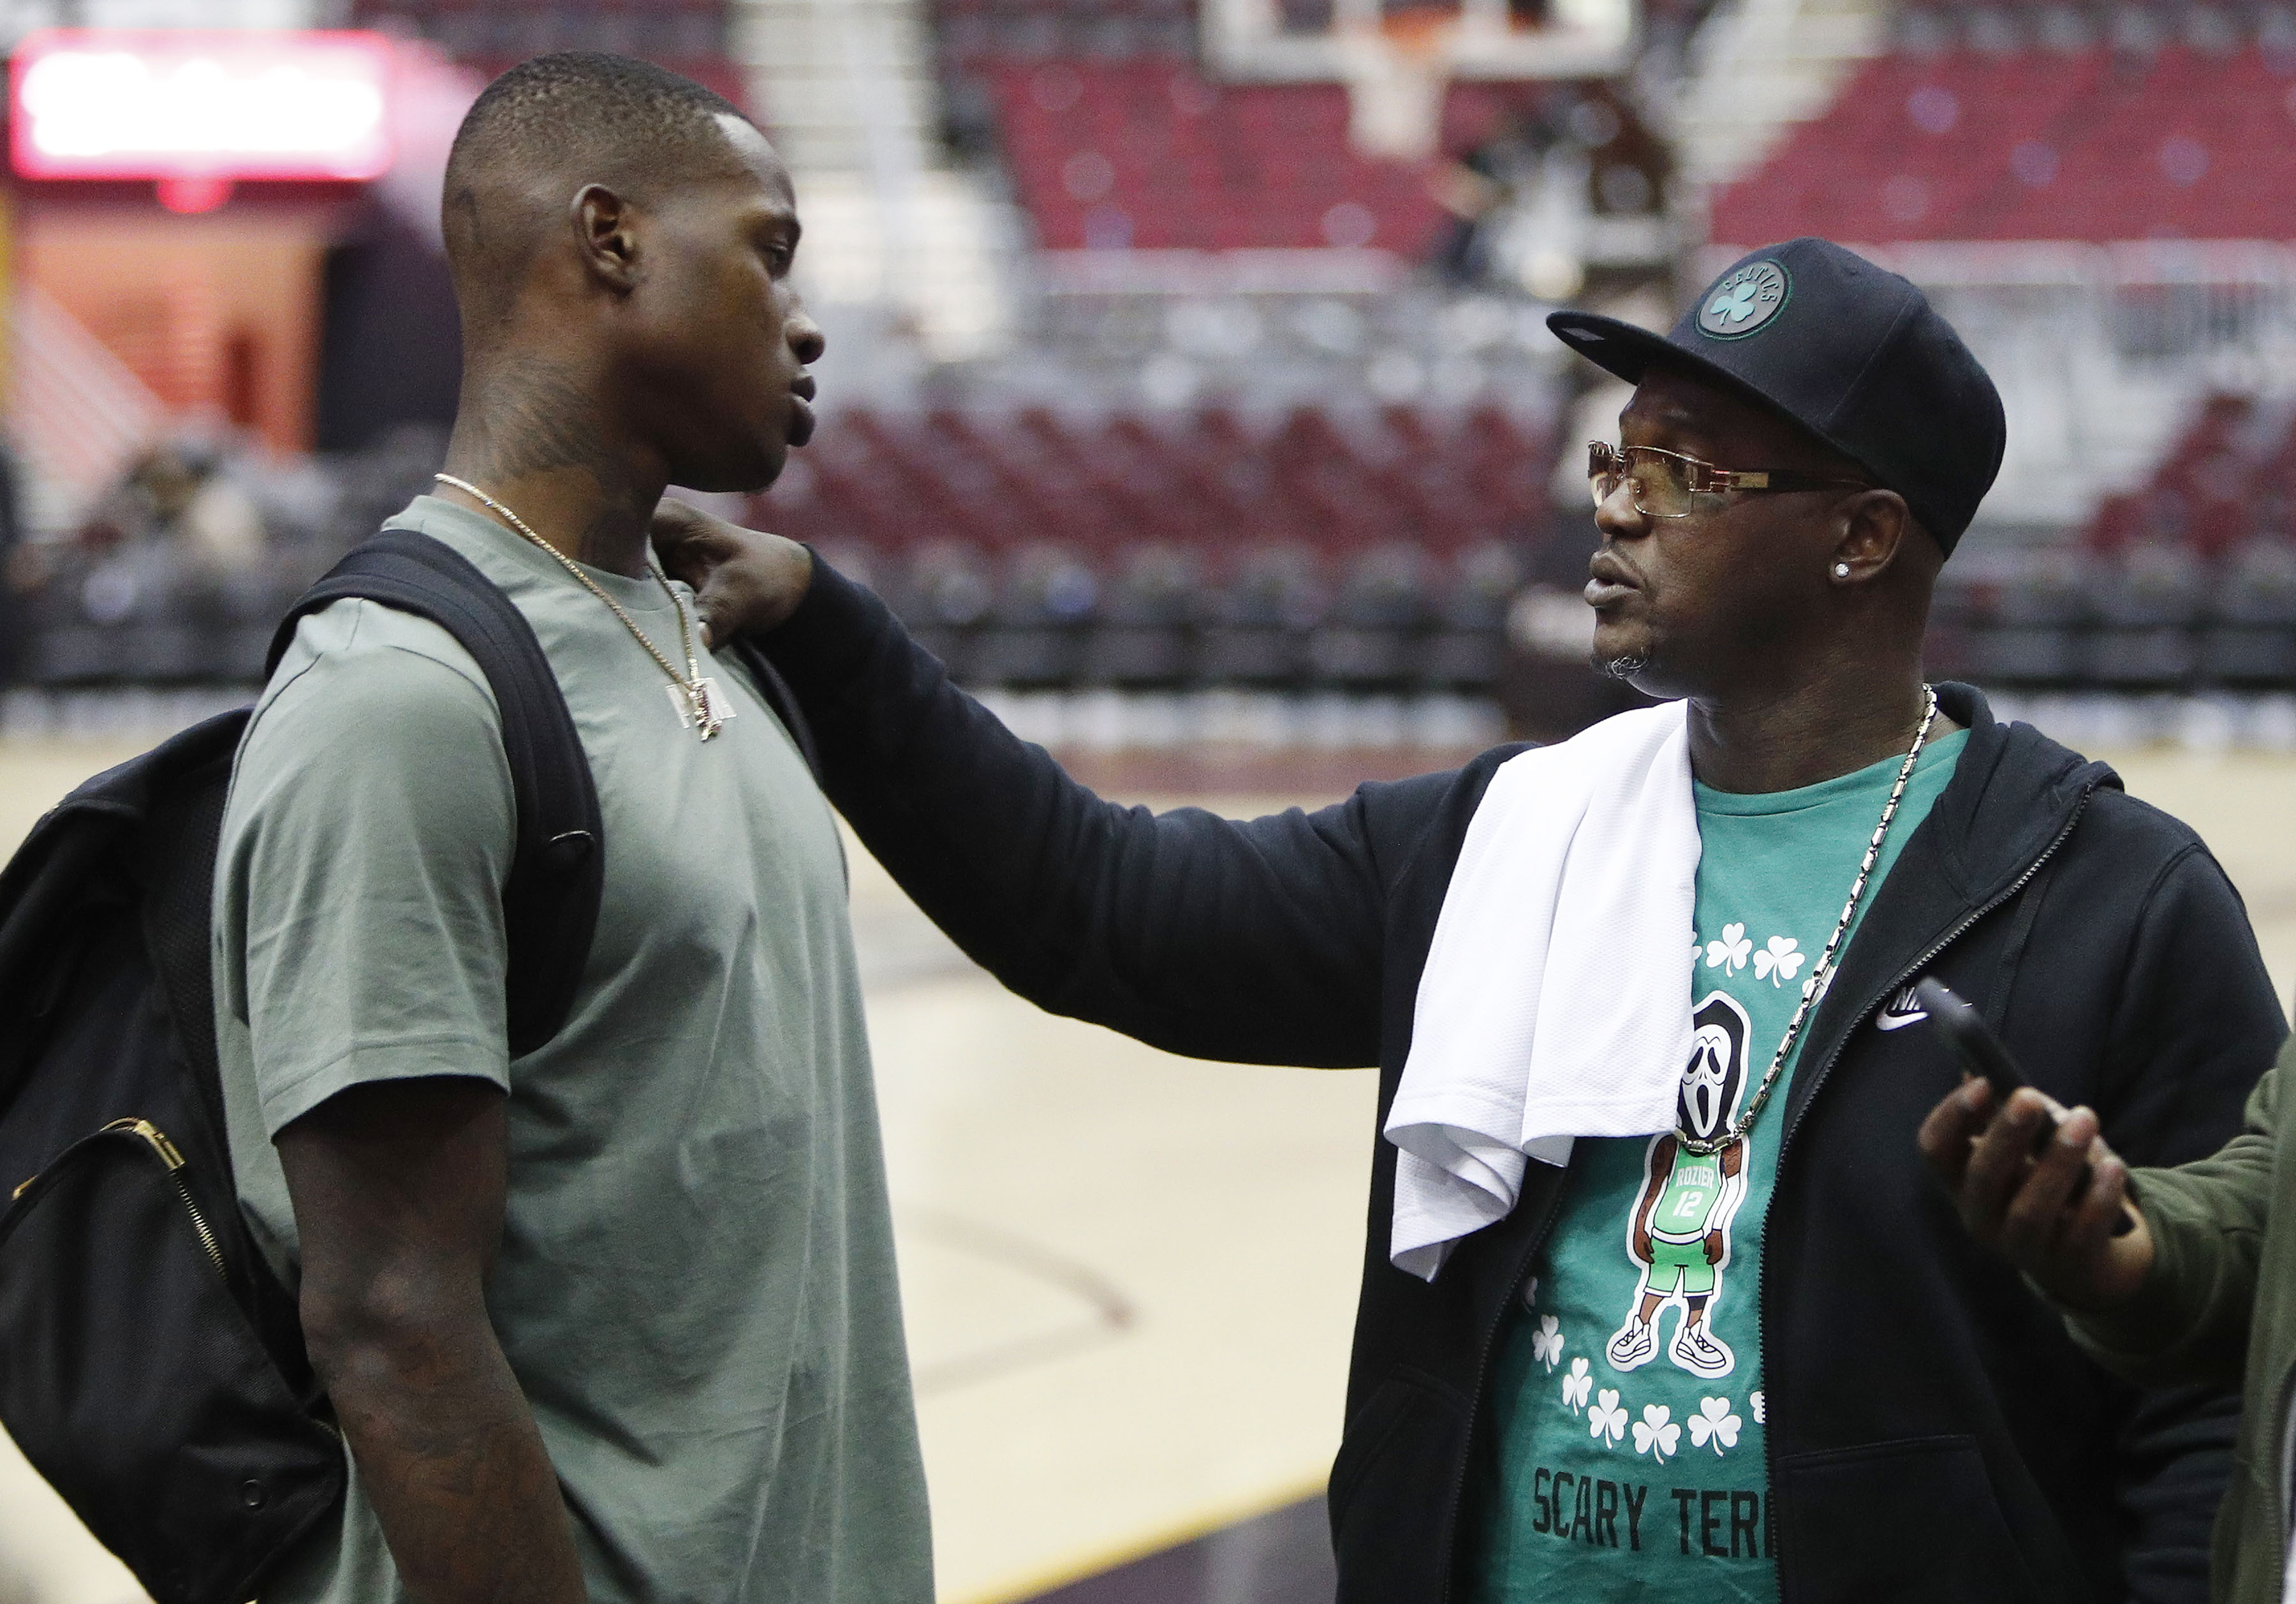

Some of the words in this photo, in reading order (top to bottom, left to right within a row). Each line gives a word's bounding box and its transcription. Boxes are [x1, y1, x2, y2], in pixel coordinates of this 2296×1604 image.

[1724, 266, 1779, 302] CELTICS
[1675, 1165, 1715, 1189] ROZIER
[1672, 1191, 1703, 1218] 12
[1532, 1467, 1647, 1551] SCARY
